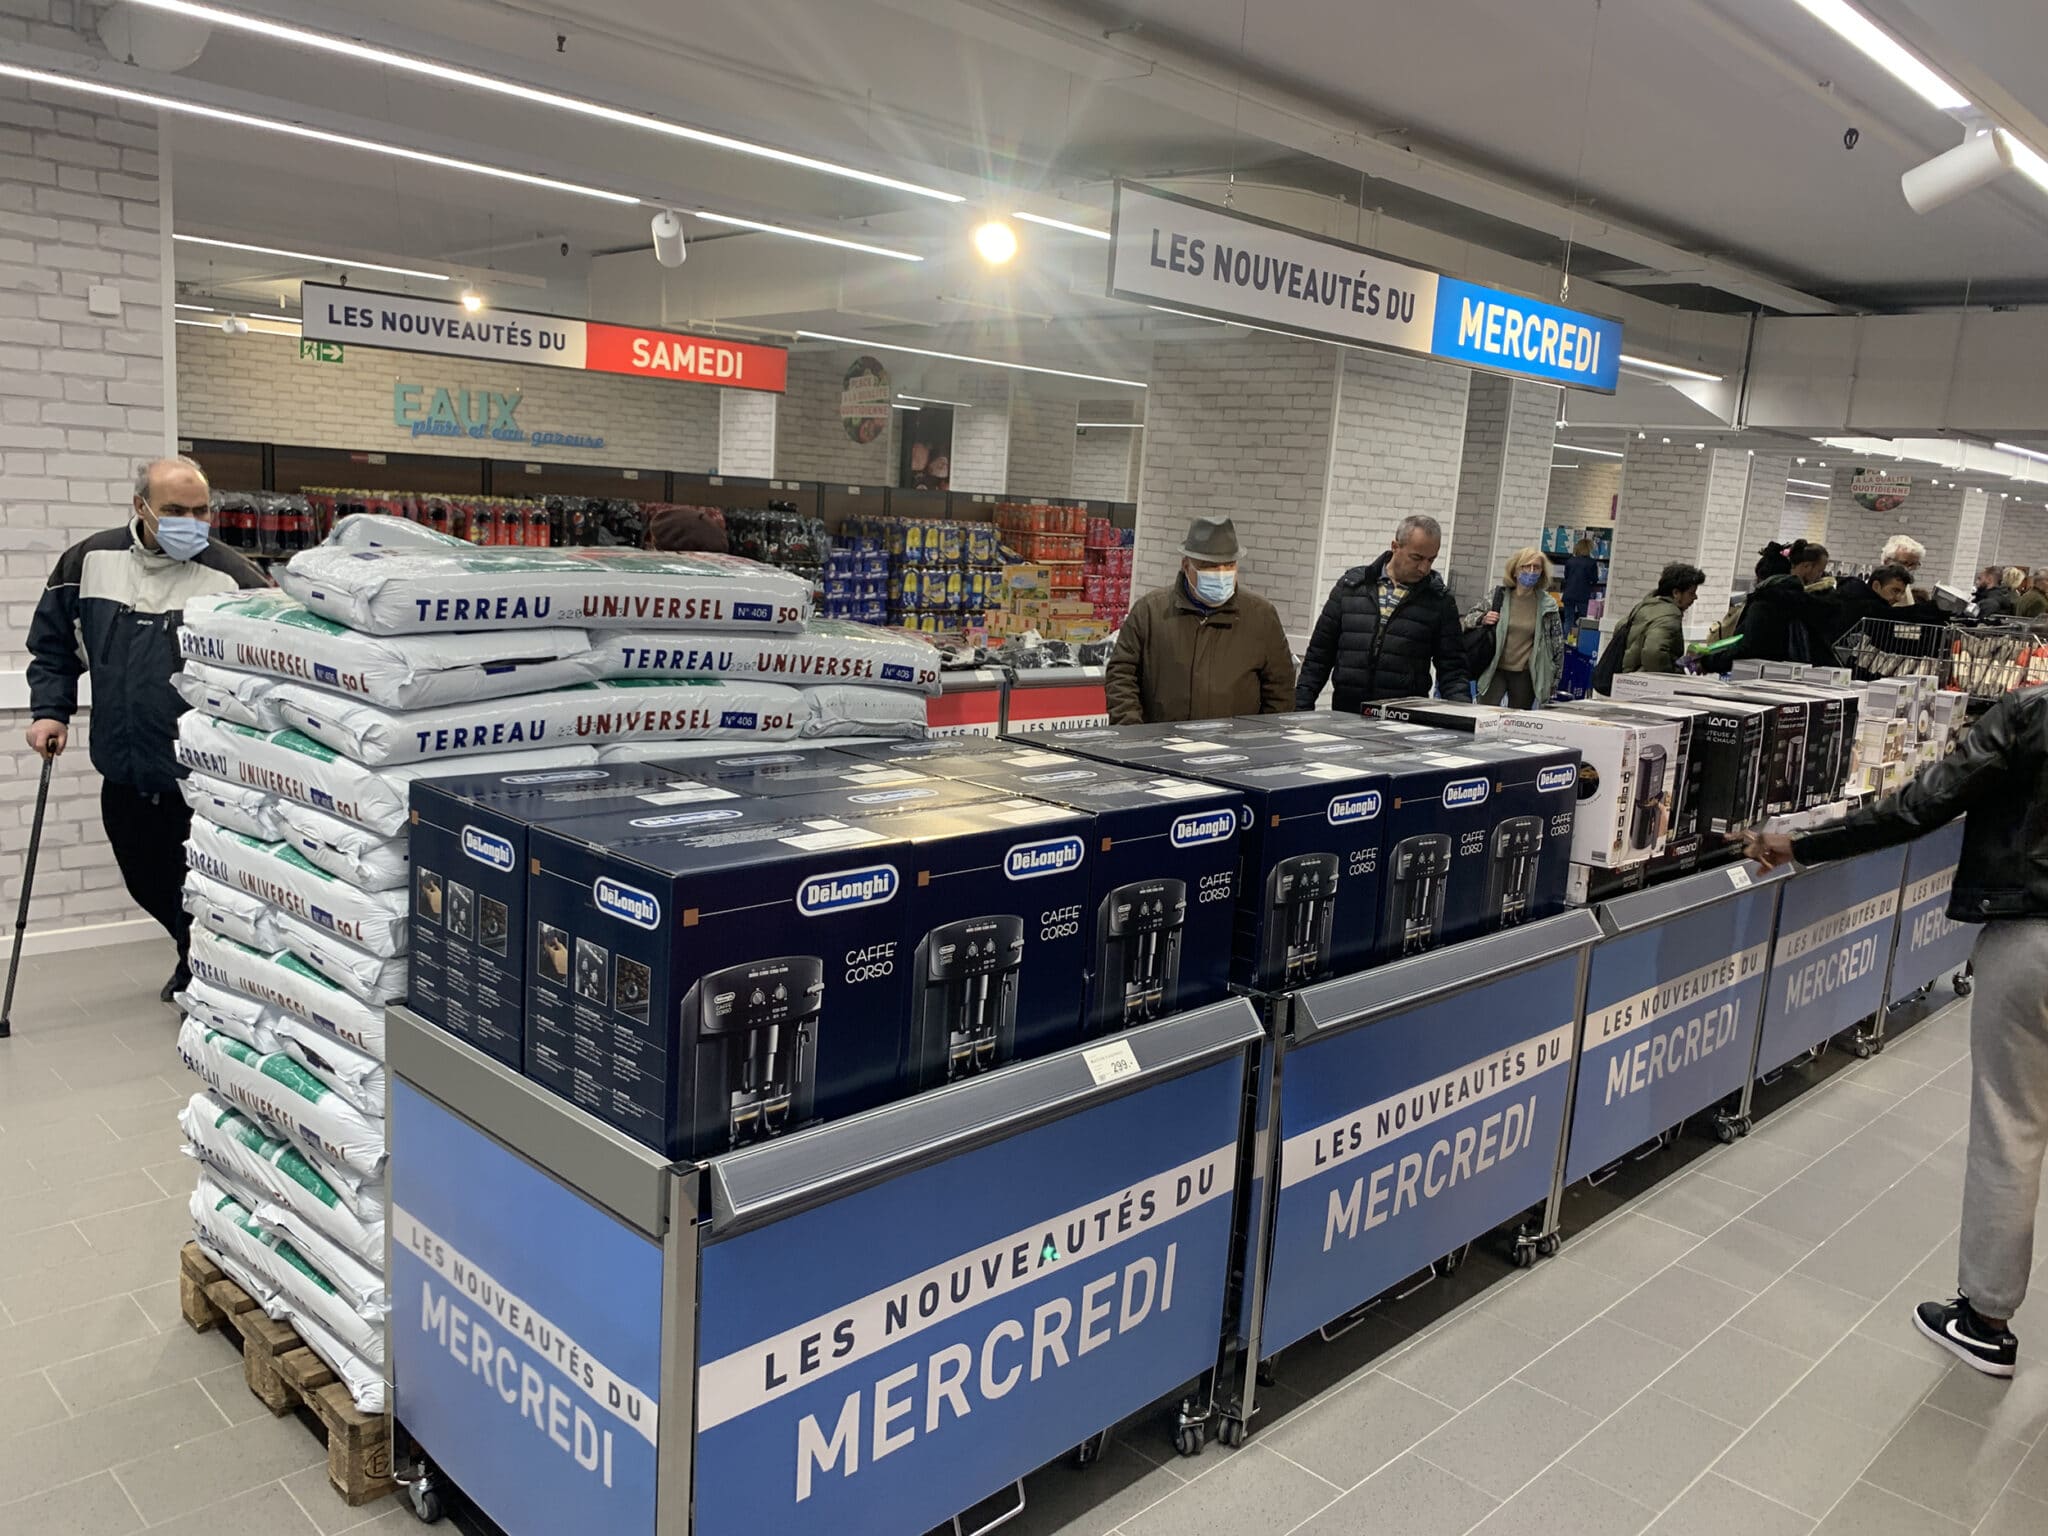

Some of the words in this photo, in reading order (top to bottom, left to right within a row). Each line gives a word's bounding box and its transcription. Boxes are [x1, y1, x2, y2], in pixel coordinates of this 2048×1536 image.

[1150, 228, 1204, 277] LES
[1213, 246, 1380, 317] NOUVEAUTÉS
[1386, 288, 1416, 324] DU
[328, 304, 373, 328] LES
[382, 312, 532, 347] NOUVEAUTÉS
[539, 331, 566, 351] DU
[1458, 297, 1601, 375] MERCREDI
[632, 338, 743, 380] SAMEDI
[394, 383, 523, 431] EAUX
[531, 431, 605, 448] gazeuse
[416, 597, 551, 621] TERREAU
[583, 595, 723, 620] UNIVERSEL
[752, 608, 768, 617] 406
[237, 643, 311, 680] UNIVERSEL
[622, 648, 732, 671] TERREAU
[757, 652, 873, 678] UNIVERSEL
[418, 720, 545, 753] TERREAU
[577, 709, 711, 737] UNIVERSEL
[737, 715, 753, 726] 406
[239, 761, 309, 803] UNIVERSEL
[1349, 861, 1376, 876] CORSO
[239, 870, 308, 918] UNIVERSEL
[1199, 886, 1230, 903] CORSO
[1040, 921, 1078, 941] CORSO
[1786, 934, 1808, 958] LES
[1811, 904, 1875, 945] NOUVEAUTÉS
[1879, 897, 1893, 915] DU
[845, 960, 893, 983] CORSO
[1602, 1008, 1633, 1036] LES
[1640, 961, 1735, 1020] NOUVEAUTÉS
[1741, 951, 1758, 977] DU
[1784, 934, 1878, 1014] MERCREDI
[1605, 998, 1741, 1106] MERCREDI
[1314, 1122, 1362, 1166] LES
[1377, 1052, 1525, 1139] NOUVEAUTÉS
[1537, 1036, 1561, 1067] DU
[1323, 1095, 1536, 1253] MERCREDI
[765, 1319, 854, 1391] LES
[885, 1189, 1156, 1336] NOUVEAUTÉS
[1176, 1163, 1216, 1207] DU
[412, 1226, 444, 1268] LES
[454, 1260, 594, 1389] NOUVEAUTÉS
[608, 1381, 642, 1422] DU
[421, 1281, 613, 1489] MERCREDI
[796, 1242, 1178, 1502] MERCREDI
